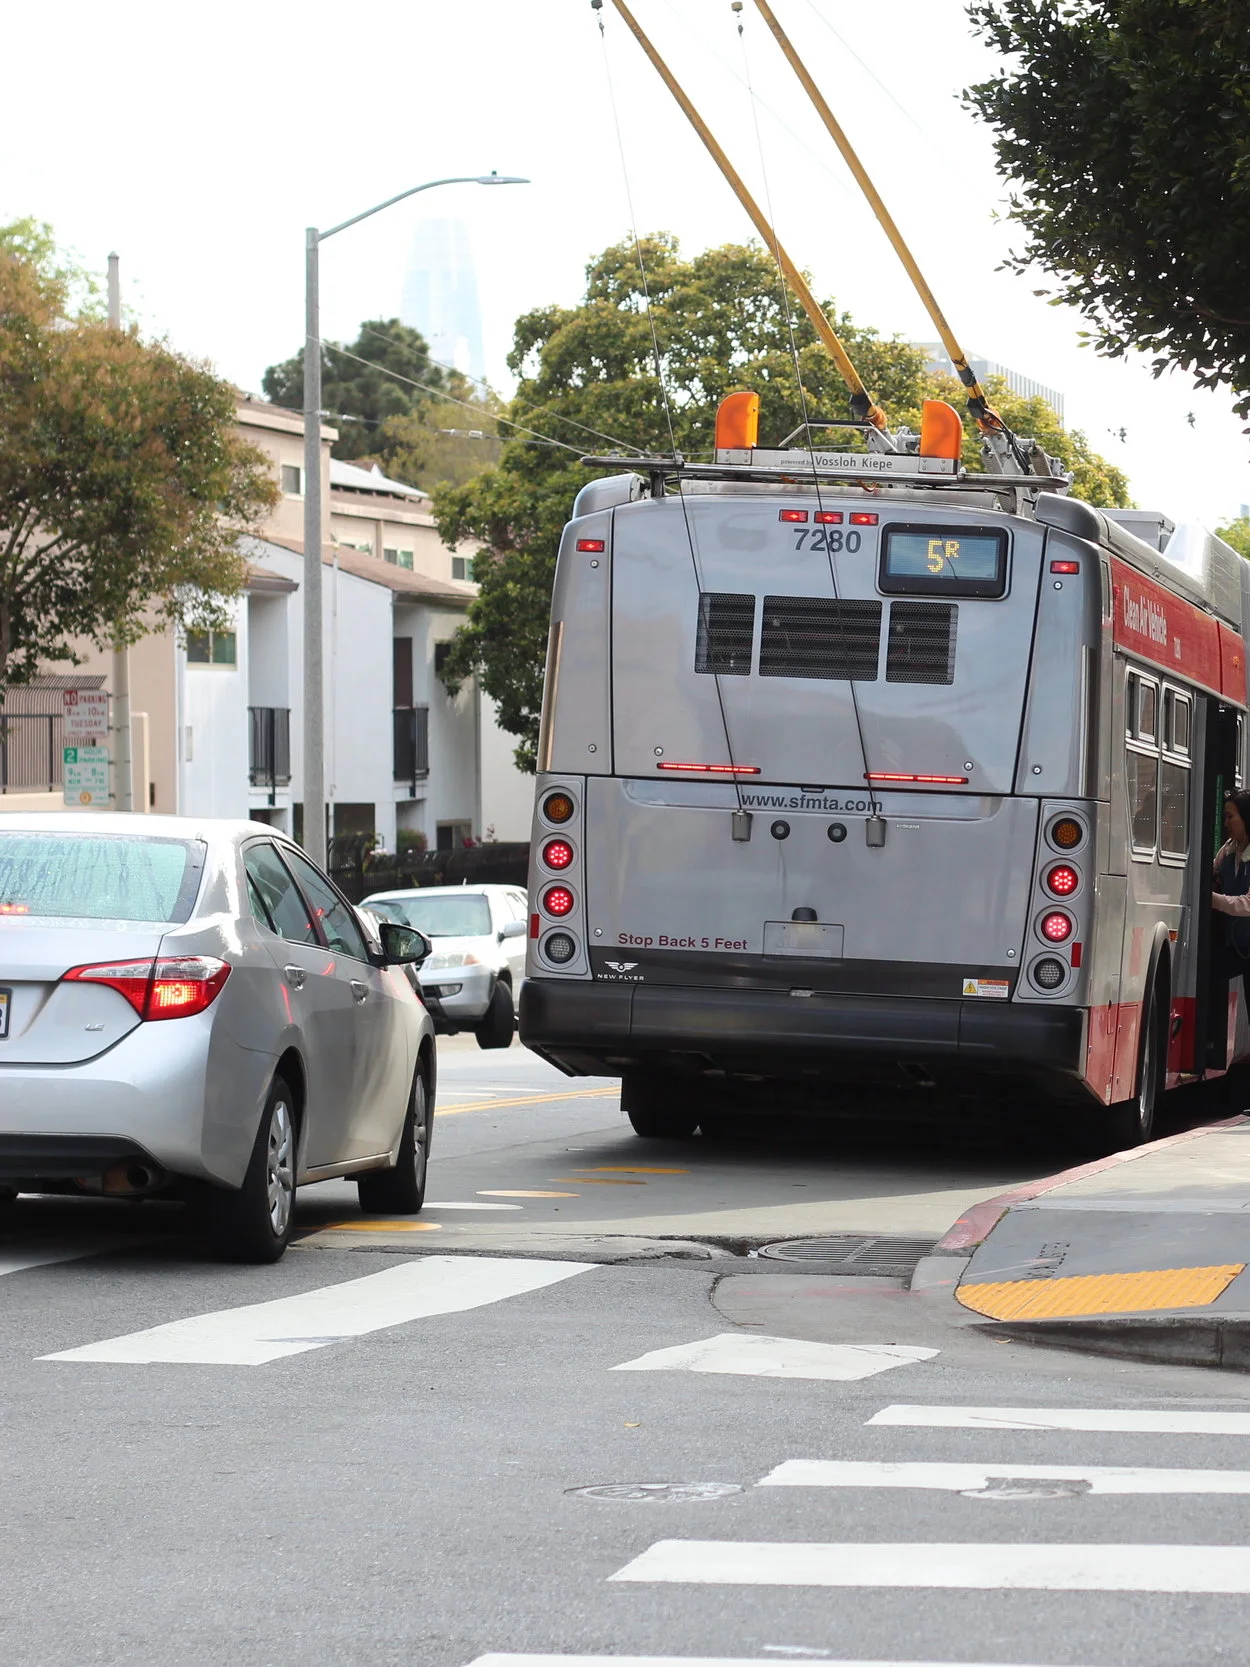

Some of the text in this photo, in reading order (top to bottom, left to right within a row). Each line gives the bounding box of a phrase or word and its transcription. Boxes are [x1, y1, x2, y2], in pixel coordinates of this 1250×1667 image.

[815, 456, 856, 467] Vossloh
[862, 458, 893, 470] Kiepe
[793, 528, 862, 554] 7280
[1123, 585, 1167, 646] Clean Air Vehicle
[64, 692, 78, 704] NO
[71, 720, 102, 728] TUESDAY
[66, 749, 76, 763] 2
[741, 793, 883, 813] www.sfmta.com
[618, 933, 748, 950] Stop Back 5 Feet
